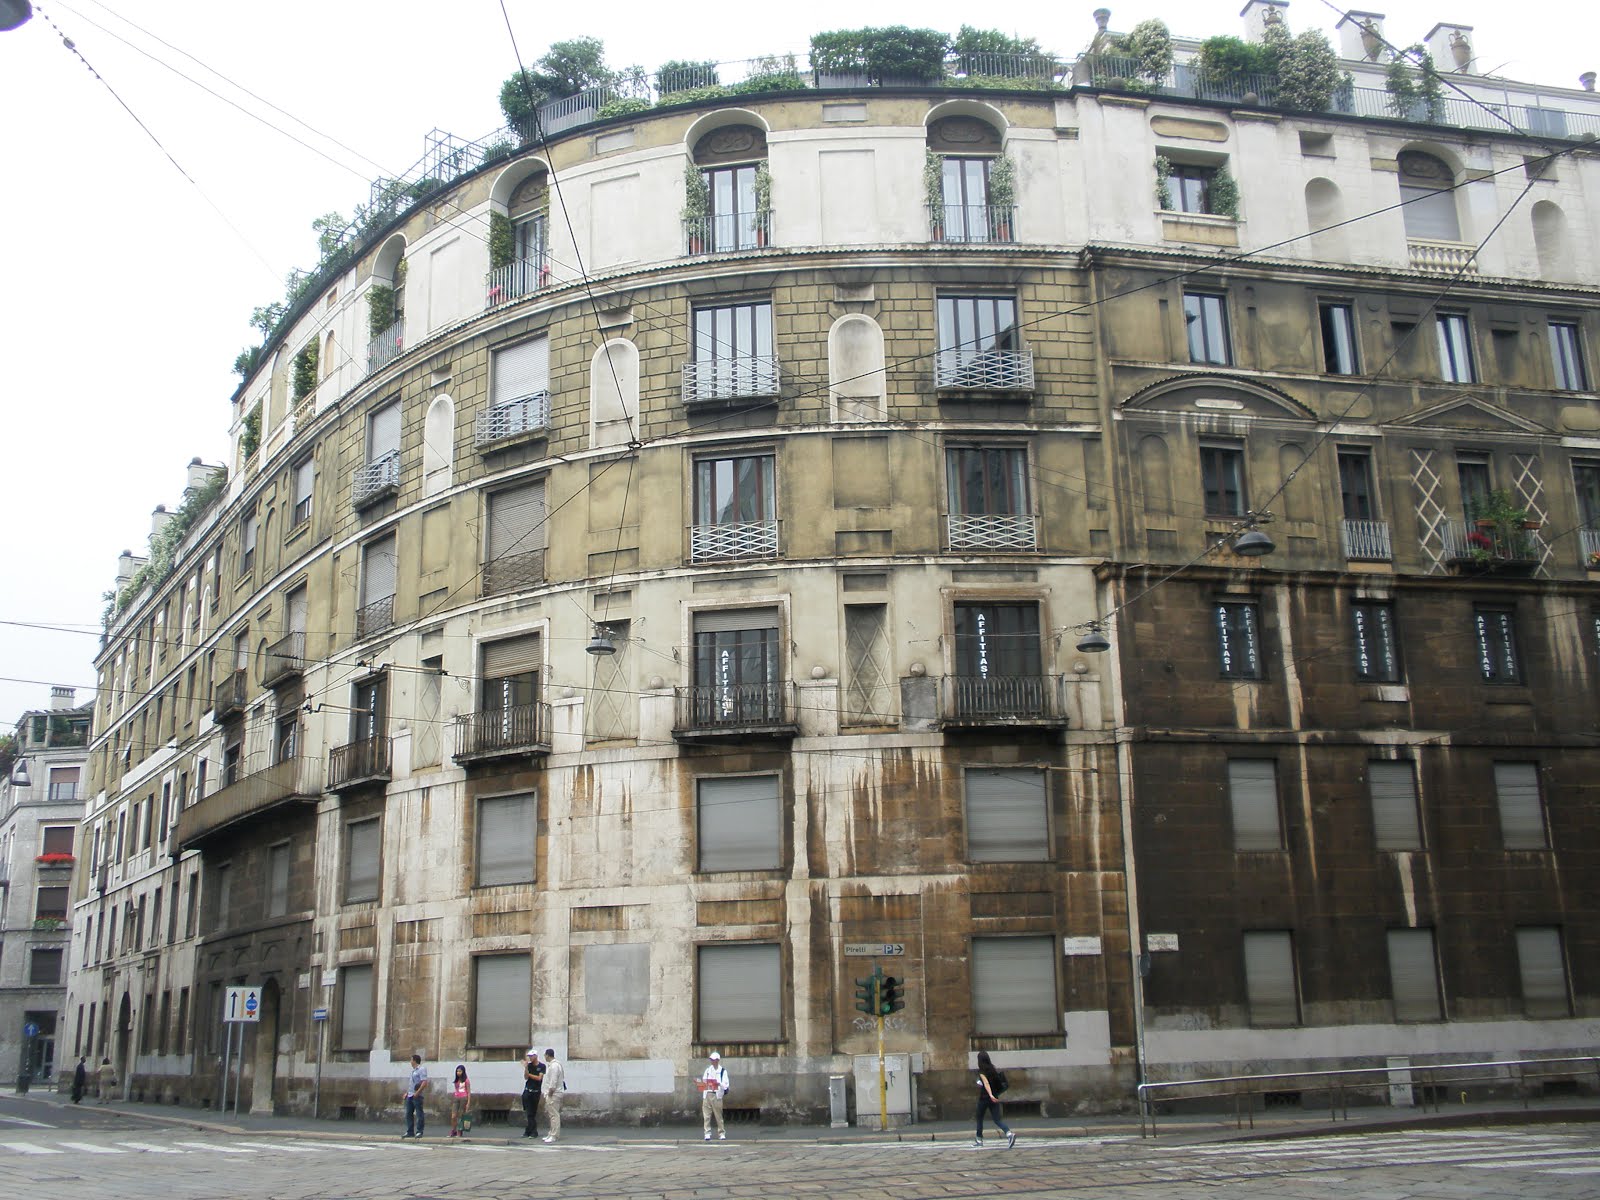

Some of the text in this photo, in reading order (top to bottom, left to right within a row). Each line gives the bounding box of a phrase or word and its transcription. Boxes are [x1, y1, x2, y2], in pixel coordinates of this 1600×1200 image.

[977, 613, 988, 679] AFFITTASI
[1219, 606, 1231, 671] AFFITTASI
[1244, 605, 1256, 669] AFFITTASI
[1356, 610, 1368, 674] AFFITTASI
[1477, 615, 1490, 677] AFFITTASI
[1500, 614, 1514, 676] AFFITTASI
[886, 945, 893, 954] P
